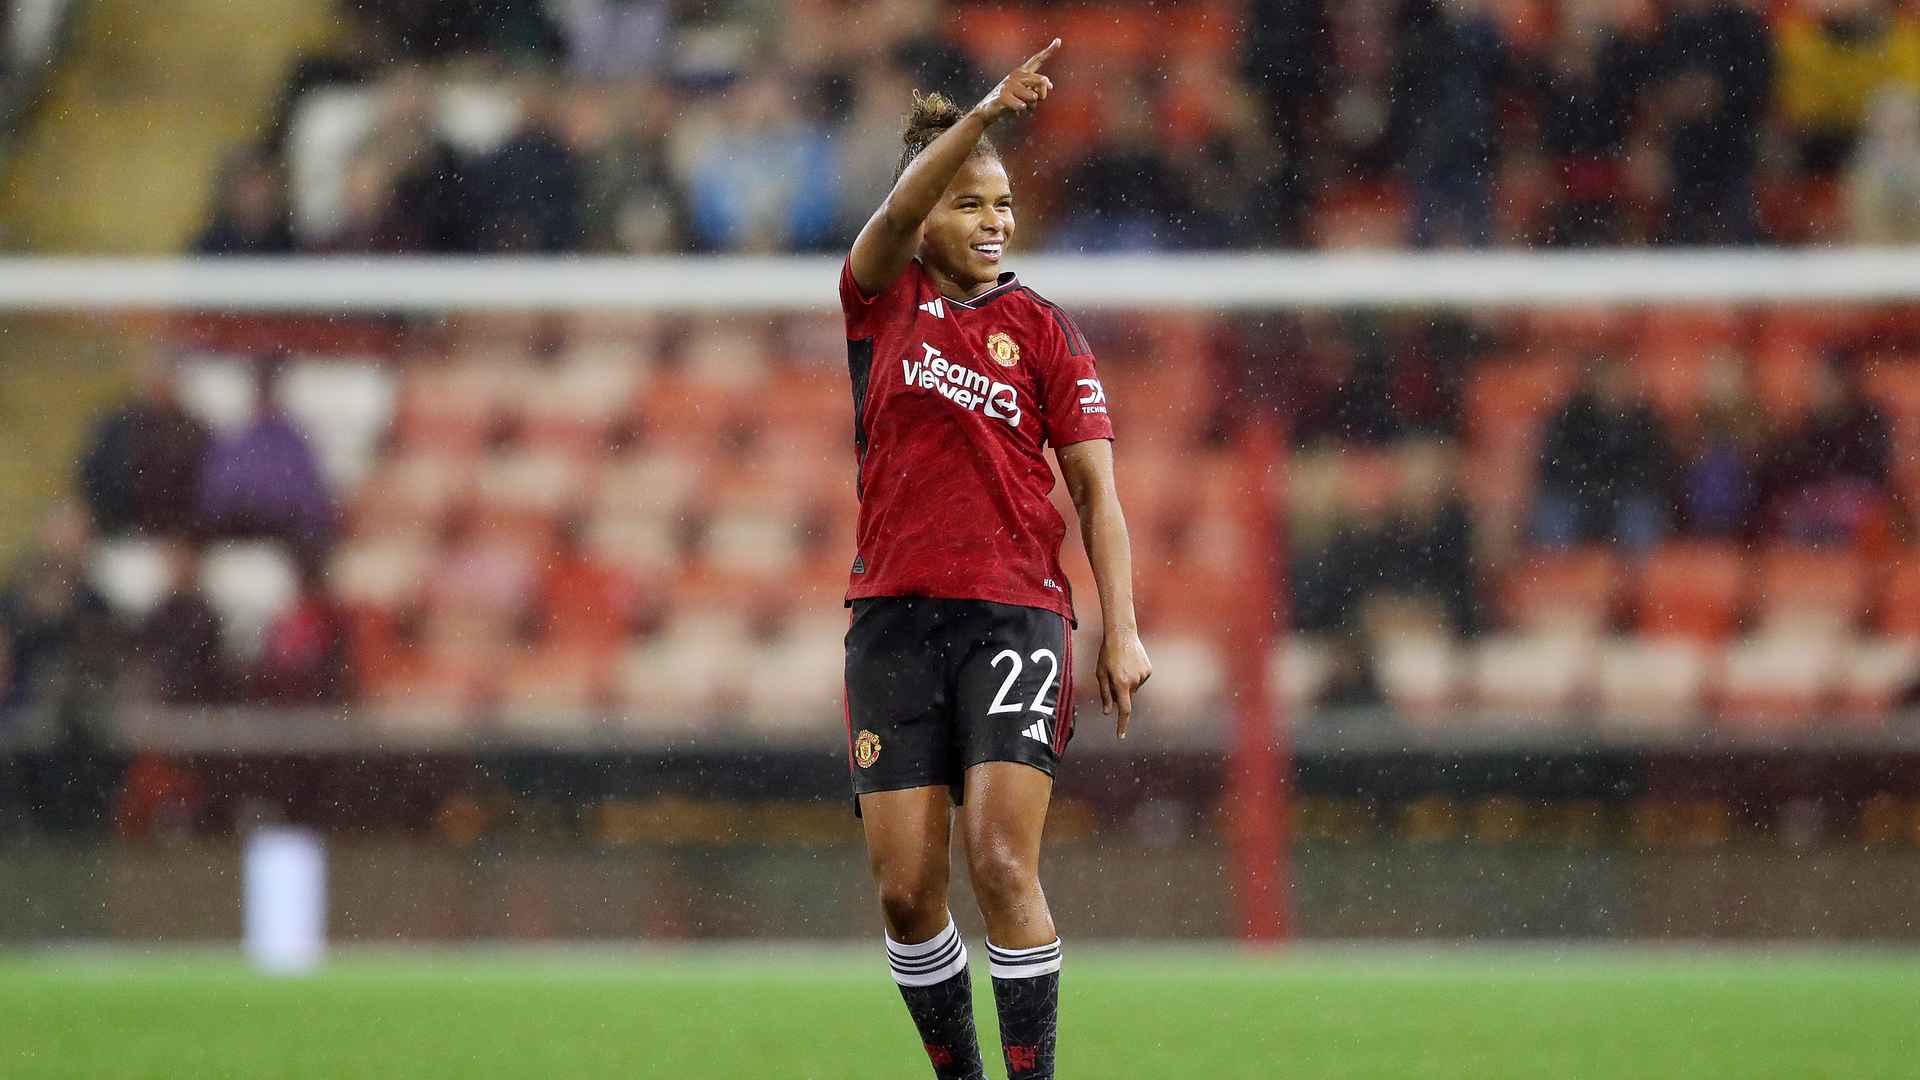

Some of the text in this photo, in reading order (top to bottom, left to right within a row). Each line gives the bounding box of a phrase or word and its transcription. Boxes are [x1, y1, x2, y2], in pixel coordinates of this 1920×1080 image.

[902, 359, 984, 411] Viewer
[922, 342, 989, 395] Team
[987, 649, 1057, 716] 22
